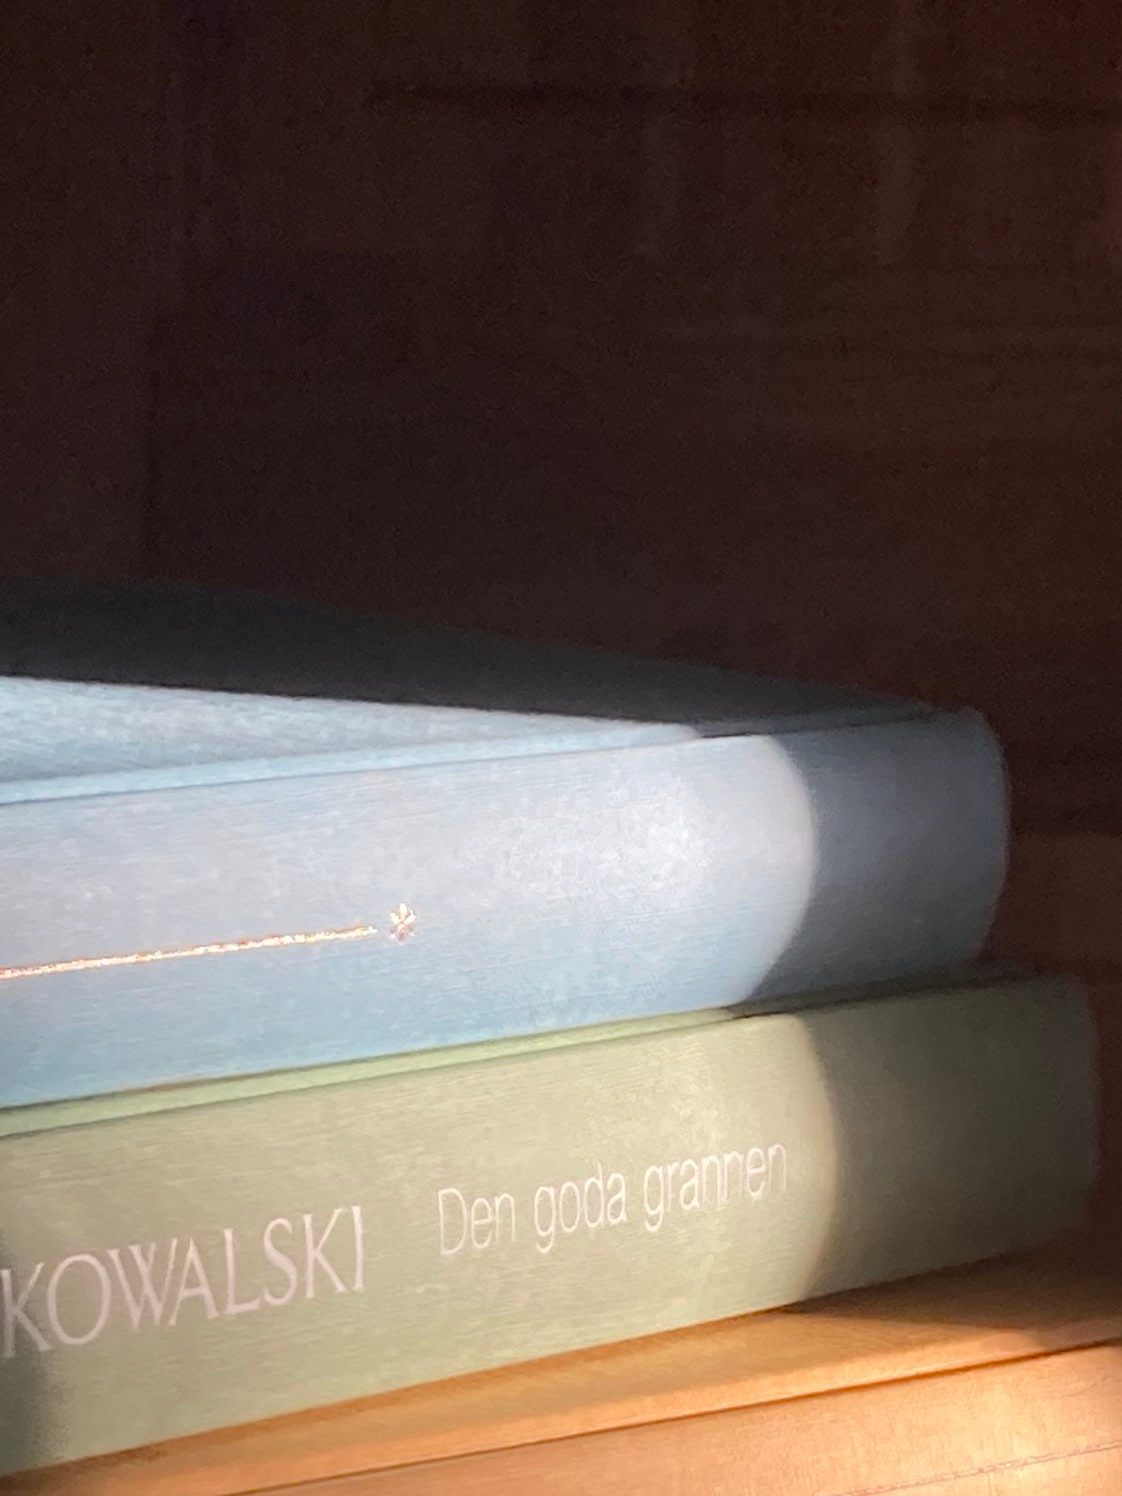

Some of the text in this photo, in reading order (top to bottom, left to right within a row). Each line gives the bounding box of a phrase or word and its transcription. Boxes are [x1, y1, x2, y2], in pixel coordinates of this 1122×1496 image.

[437, 1141, 788, 1256] Den goda grannen
[0, 1204, 366, 1359] KOWALSKI
